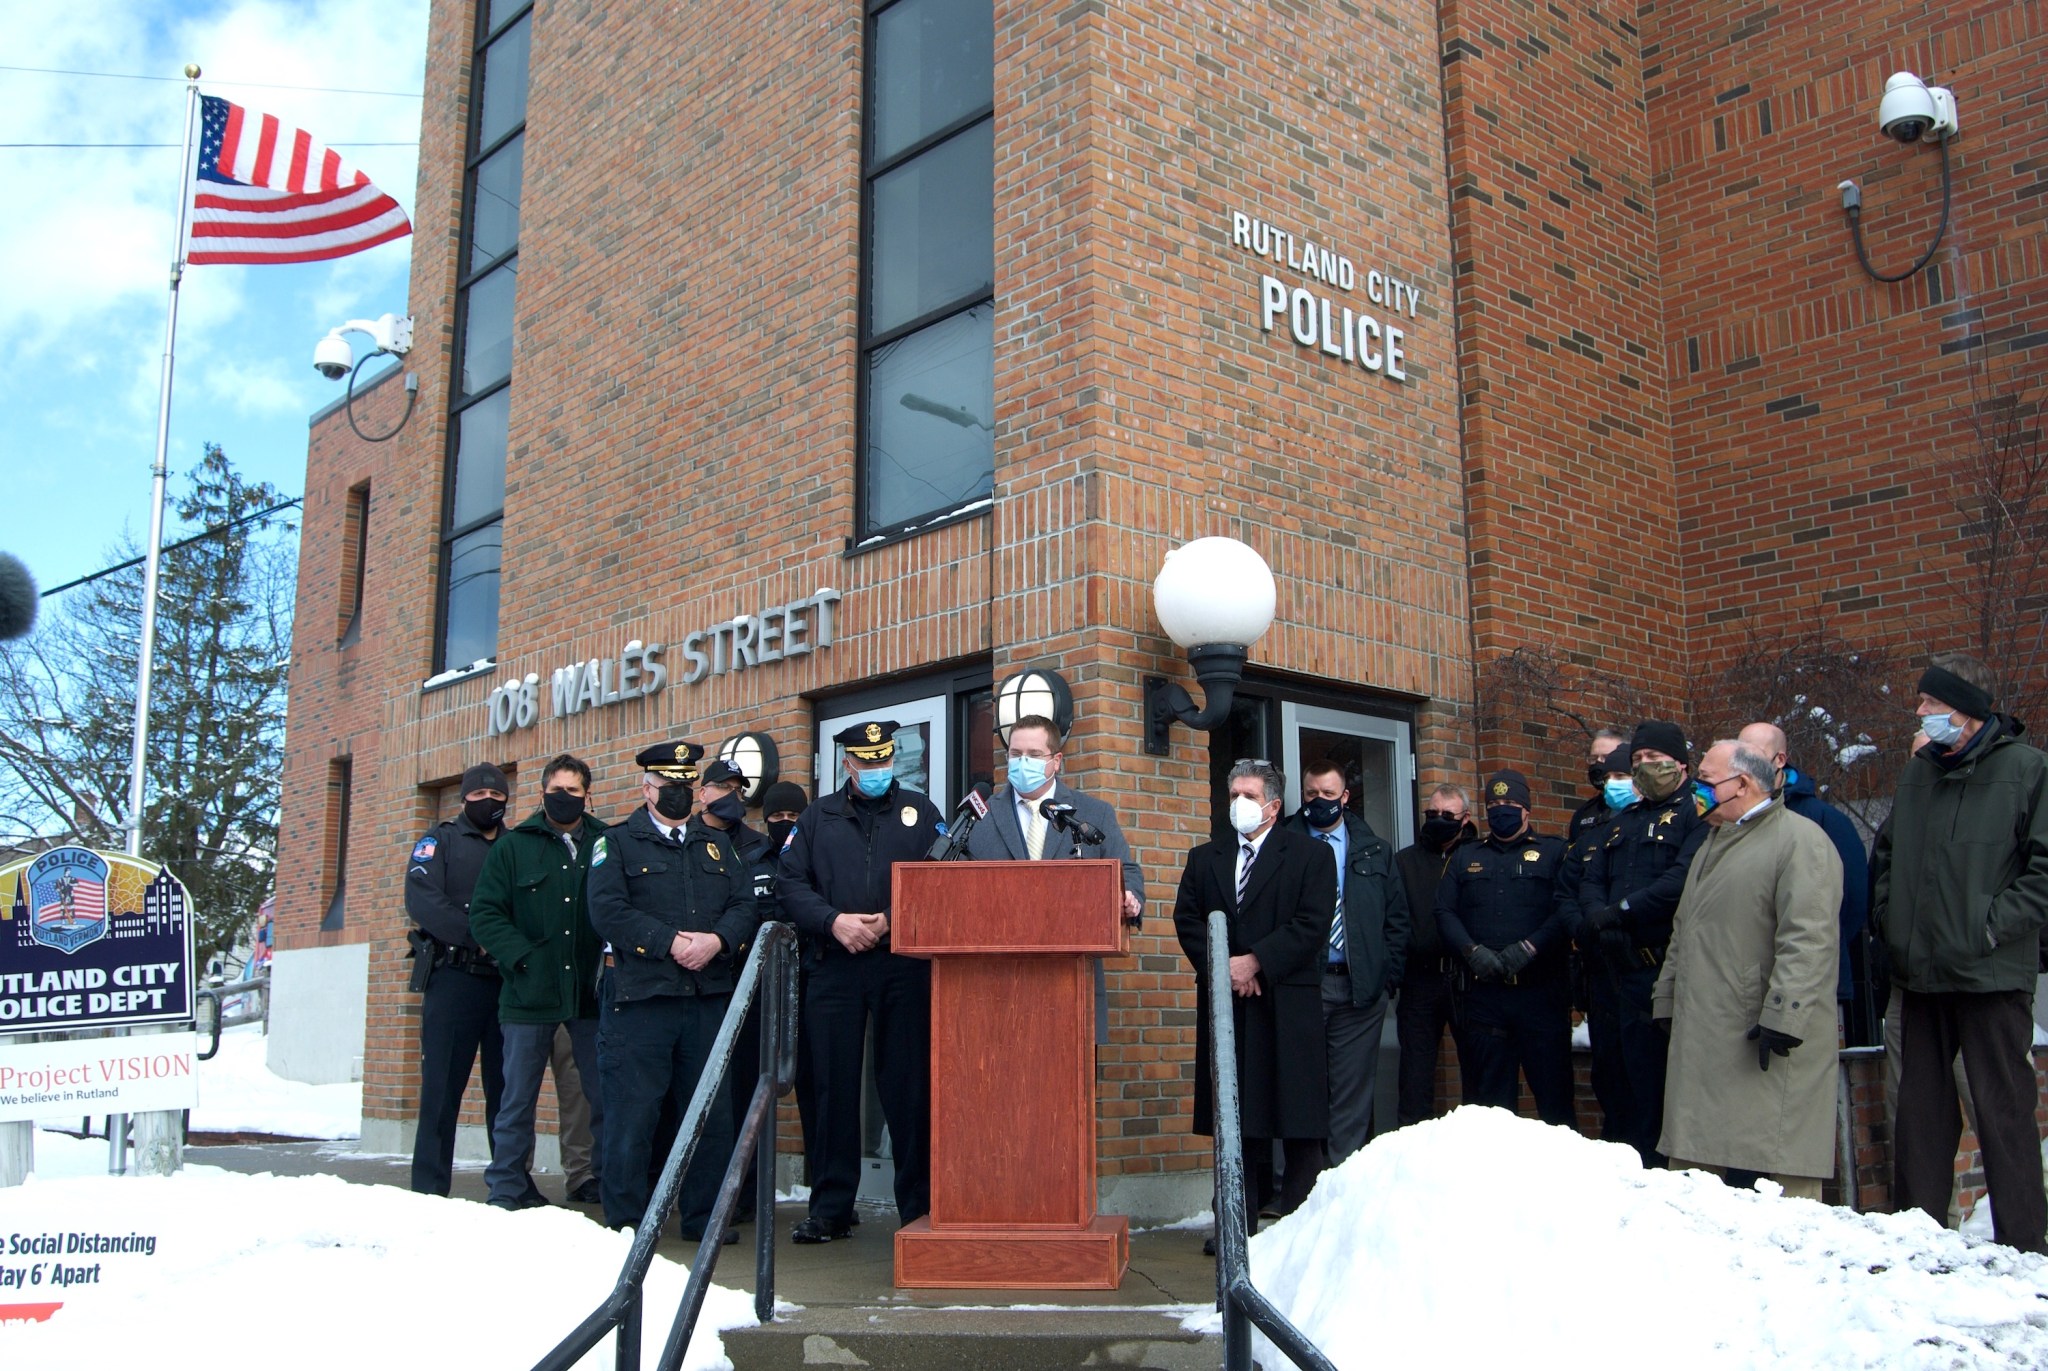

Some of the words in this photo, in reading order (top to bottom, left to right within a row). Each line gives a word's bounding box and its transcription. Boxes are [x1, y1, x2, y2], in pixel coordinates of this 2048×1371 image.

[1232, 210, 1355, 291] RUTLAND
[1366, 270, 1420, 318] CITY
[1260, 274, 1406, 382] POLICE
[485, 675, 539, 737] 108
[551, 642, 666, 718] WALES
[683, 590, 842, 684] STREET
[35, 851, 100, 873] POLICE
[34, 926, 69, 946] RUTLAND
[69, 921, 104, 947] VERMONT
[0, 967, 107, 995] TLAND
[112, 962, 180, 987] CITY
[88, 988, 167, 1014] DEPT
[0, 1063, 92, 1093] Project
[98, 1053, 191, 1082] VISION
[0, 1095, 18, 1105] We
[21, 1092, 61, 1104] believe
[63, 1090, 74, 1101] in
[76, 1087, 119, 1100] Rutland
[9, 1233, 63, 1255] Social
[66, 1232, 157, 1256] Distancing
[51, 1263, 101, 1288] Apart
